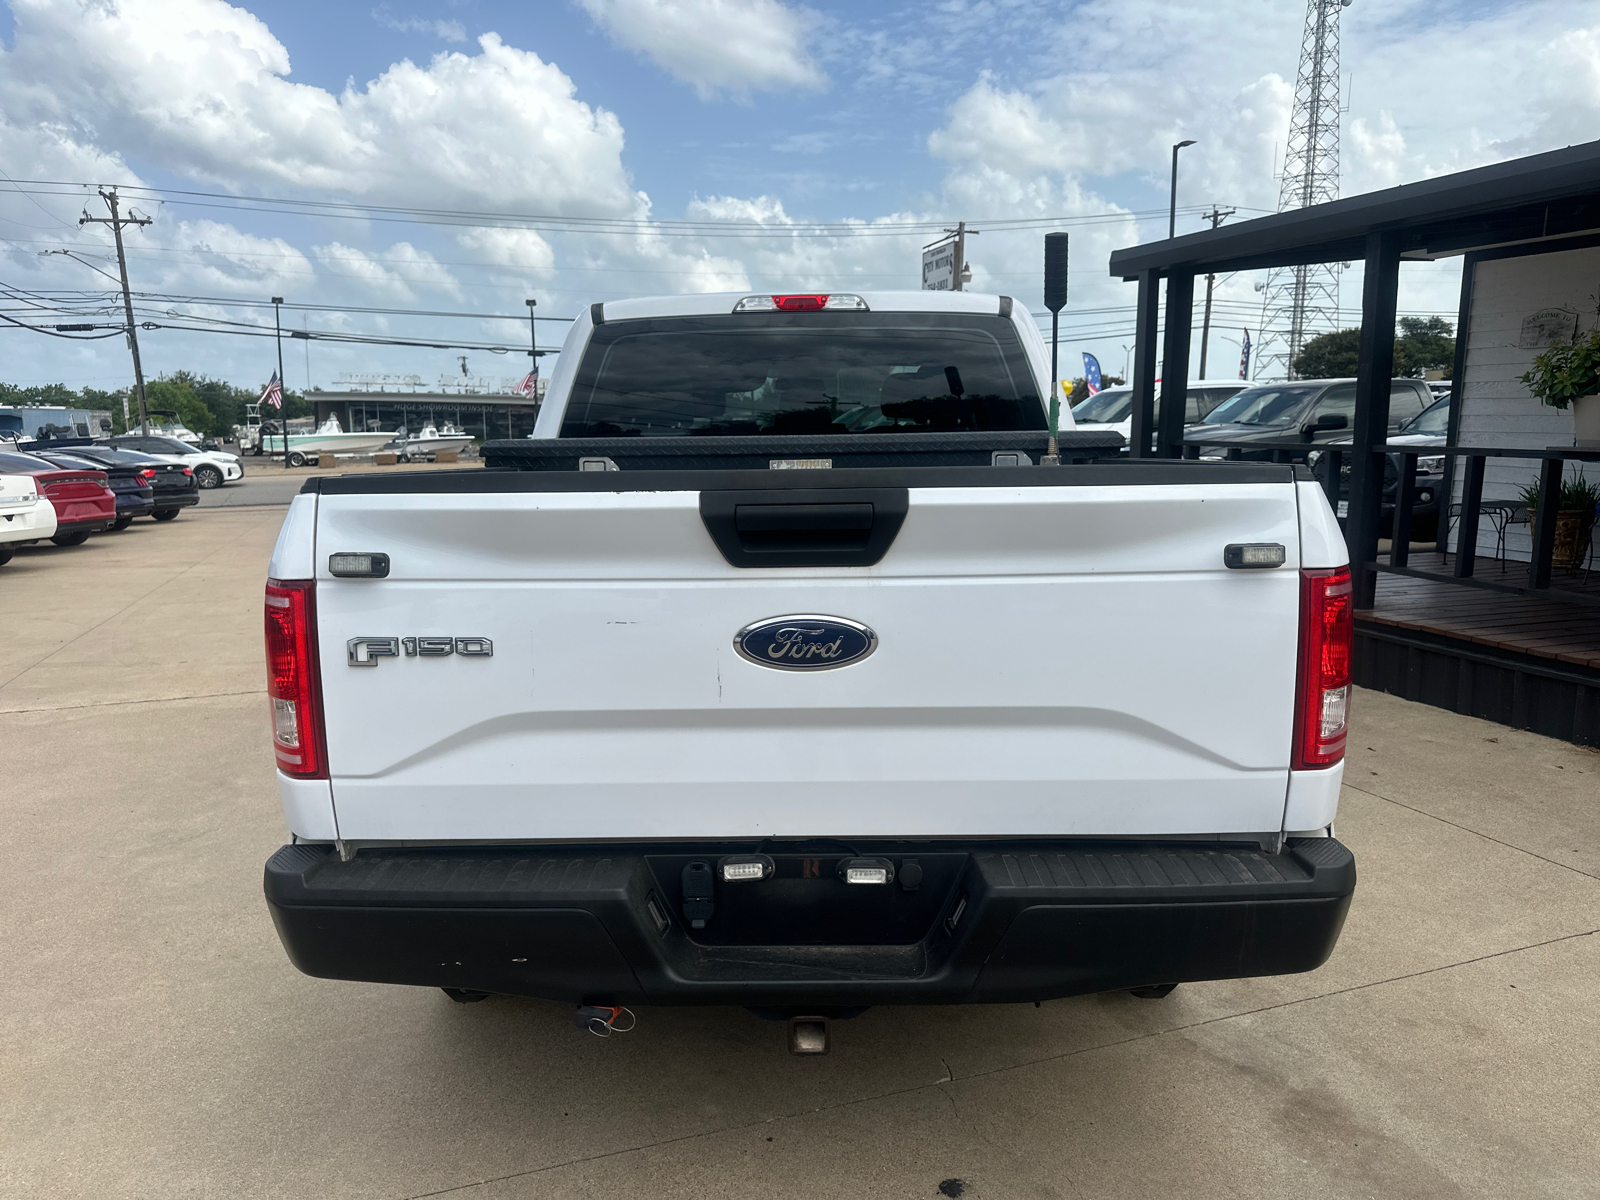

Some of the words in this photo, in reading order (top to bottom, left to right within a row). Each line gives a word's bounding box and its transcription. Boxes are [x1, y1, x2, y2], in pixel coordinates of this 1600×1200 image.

[1526, 312, 1560, 324] WELCOME
[394, 403, 417, 411] HUGE
[418, 404, 468, 412] SHOWROOM
[468, 405, 494, 413] INSIDE
[767, 627, 844, 659] Ford
